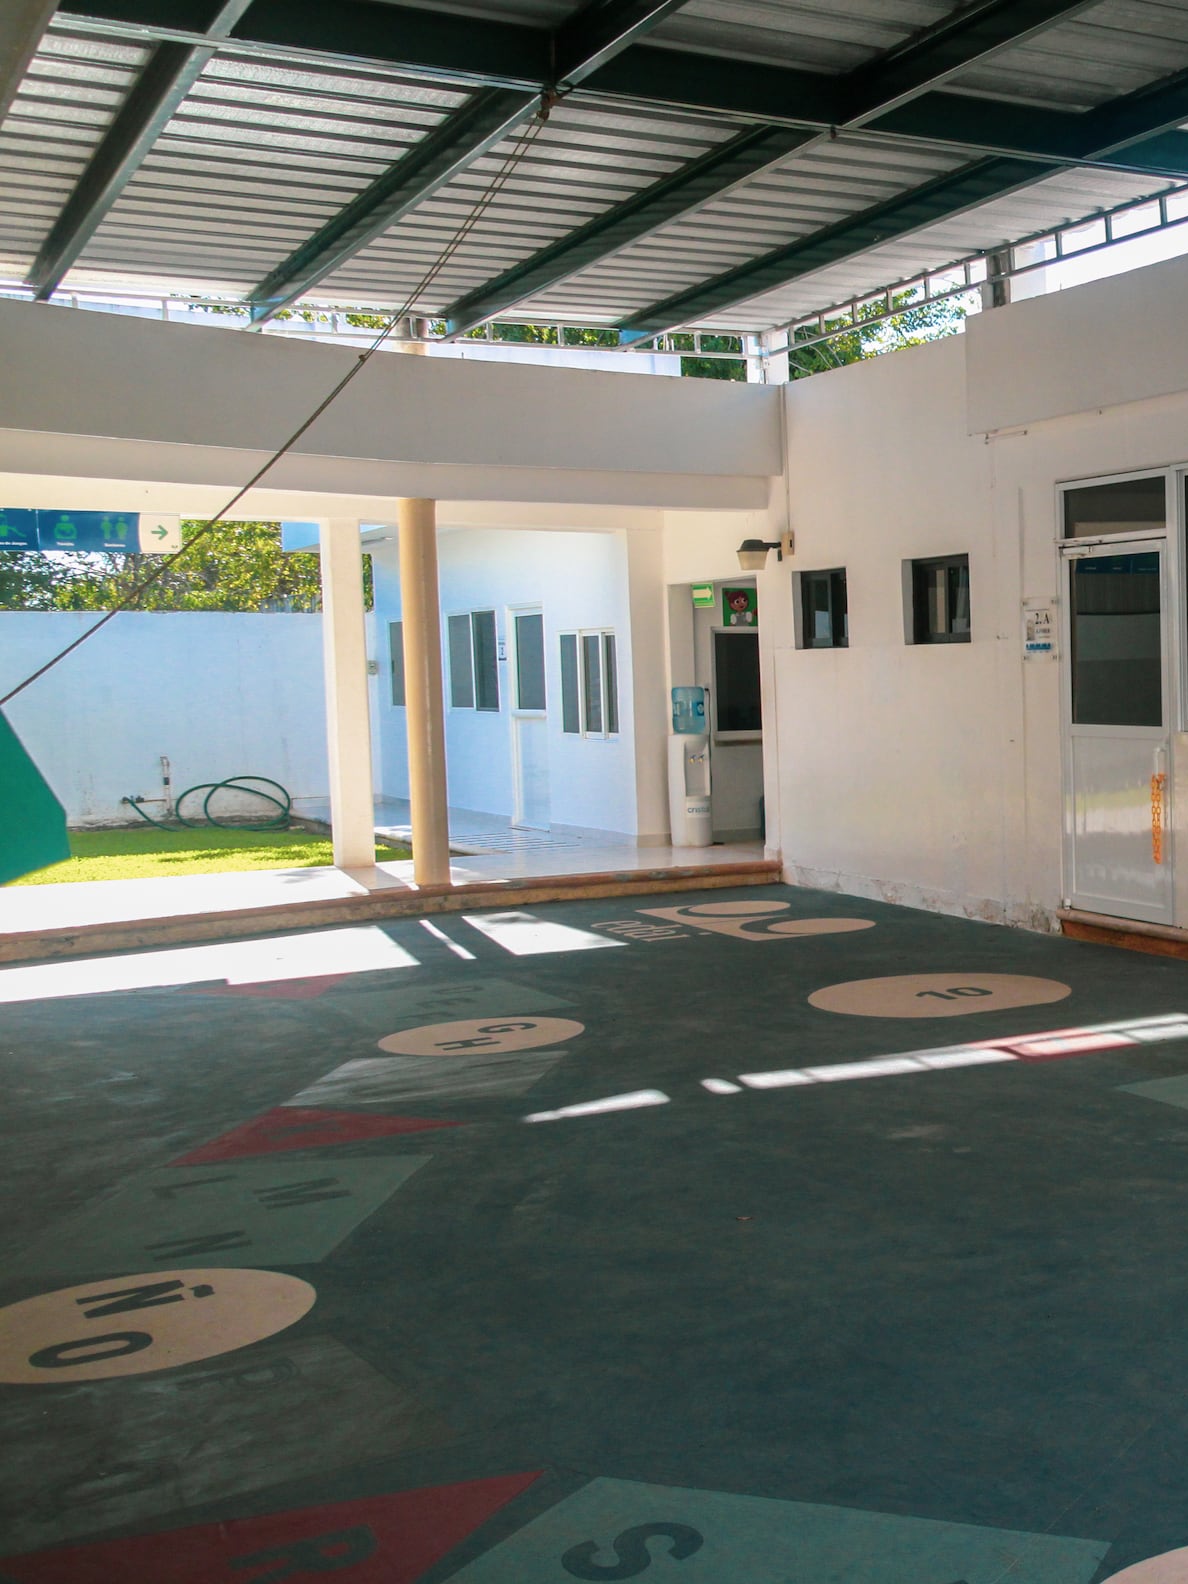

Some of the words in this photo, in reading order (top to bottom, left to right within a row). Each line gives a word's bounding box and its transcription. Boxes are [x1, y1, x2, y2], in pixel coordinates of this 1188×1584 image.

[916, 987, 993, 1001] 10
[477, 1022, 537, 1035] G
[434, 1036, 501, 1051] H
[29, 1331, 154, 1369] O
[561, 1522, 704, 1581] S
